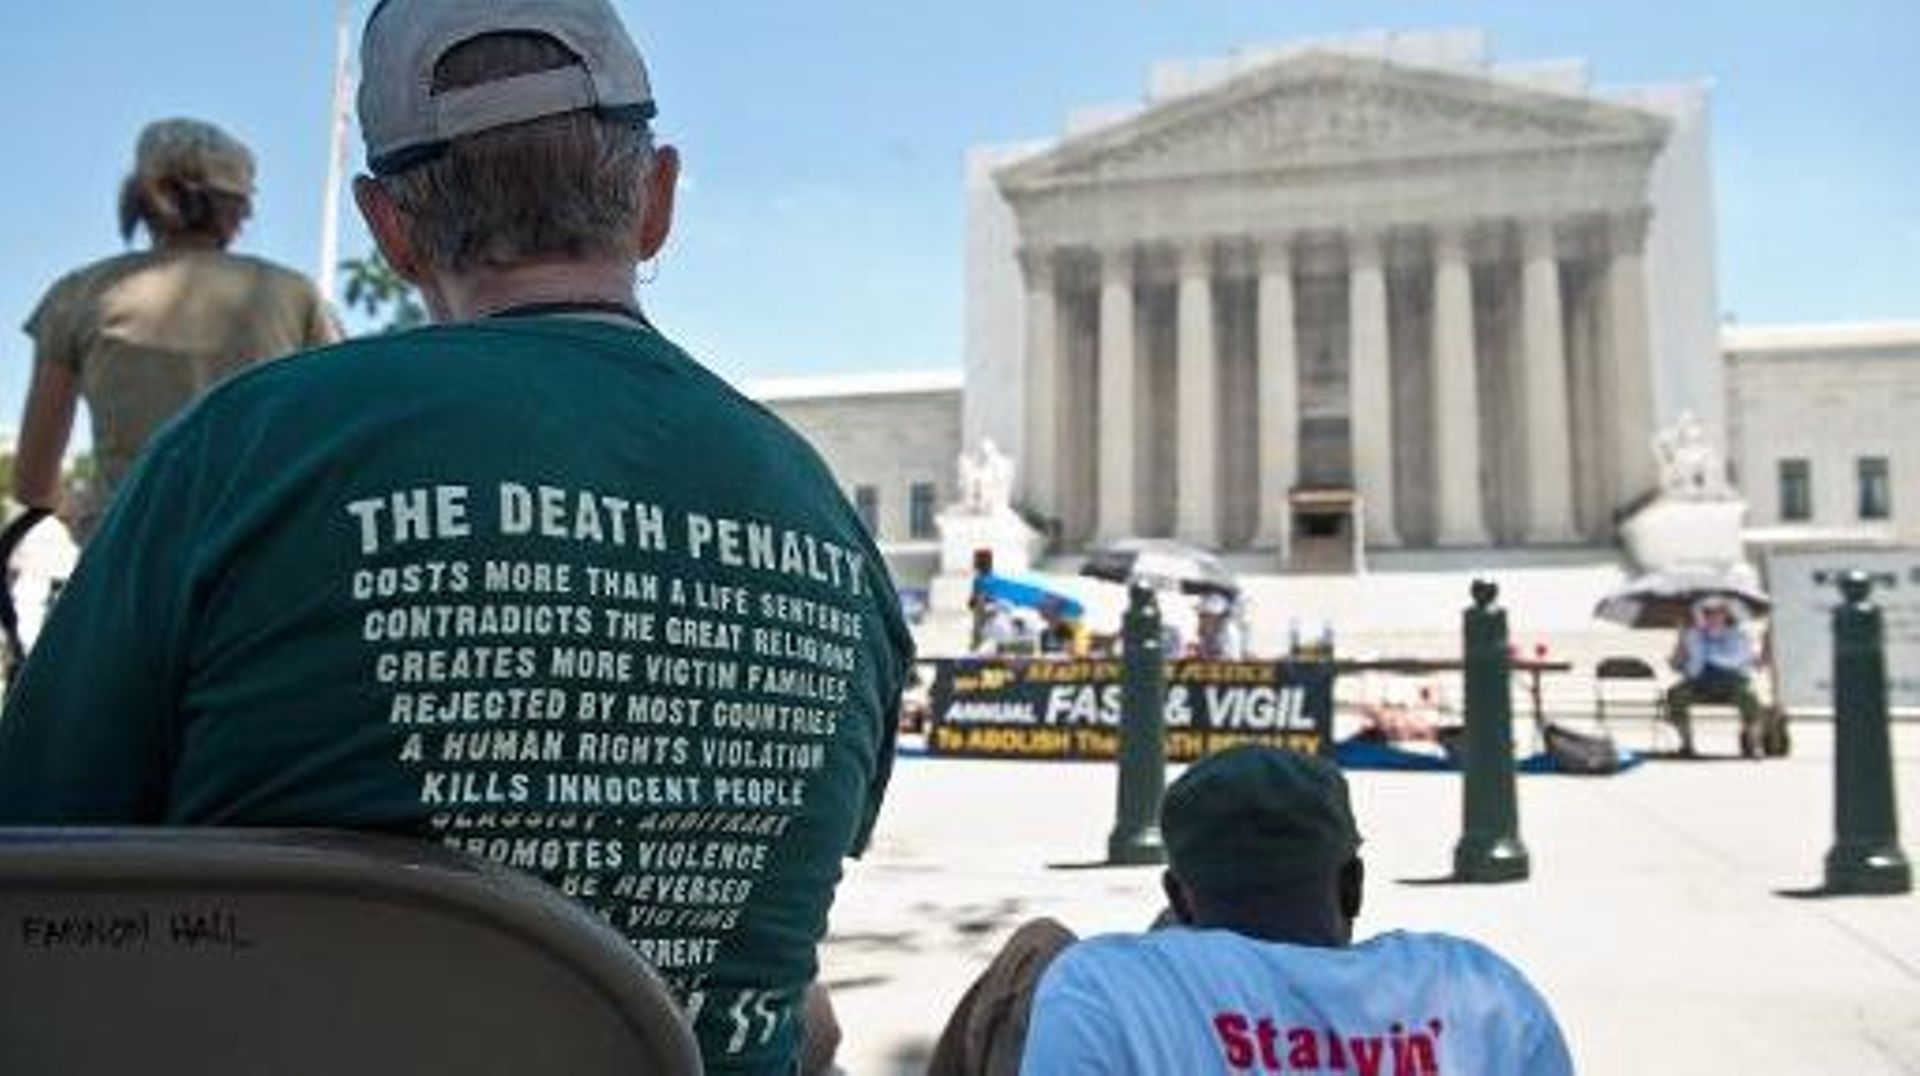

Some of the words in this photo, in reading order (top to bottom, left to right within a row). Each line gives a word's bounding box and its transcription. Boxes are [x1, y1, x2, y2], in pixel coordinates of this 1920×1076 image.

[347, 486, 471, 554] THE
[499, 482, 668, 551] DEATH
[687, 513, 864, 596] PENALTY
[353, 561, 469, 600] COSTS
[485, 561, 571, 594] MORE
[587, 567, 657, 600] THAN
[670, 579, 686, 605] A
[695, 582, 749, 614] LIFE
[761, 593, 863, 640] SENTENCE
[364, 605, 593, 640] CONTRADICTS
[605, 609, 654, 640] THE
[665, 616, 743, 651] GREAT
[377, 647, 536, 682] CREATES
[550, 648, 632, 679] MORE
[748, 665, 848, 702] FAMILIES
[390, 688, 566, 724] REJECTED
[578, 691, 615, 722] BY
[628, 694, 702, 728] MOST
[713, 700, 837, 735] COUNTRIES
[1044, 684, 1121, 725] FAS
[1204, 686, 1316, 730] VIGIL
[400, 732, 423, 761] A
[442, 730, 564, 763] HUMAN
[579, 731, 690, 765] RIGHTS
[702, 738, 825, 769] VIOLATION
[420, 772, 529, 803] KILLS
[547, 773, 700, 803] INNOCENT
[713, 777, 805, 806] PEOPLE
[443, 837, 622, 870] ROMOTES
[638, 841, 769, 870] VIOLENCE
[612, 874, 753, 904] REVERSED
